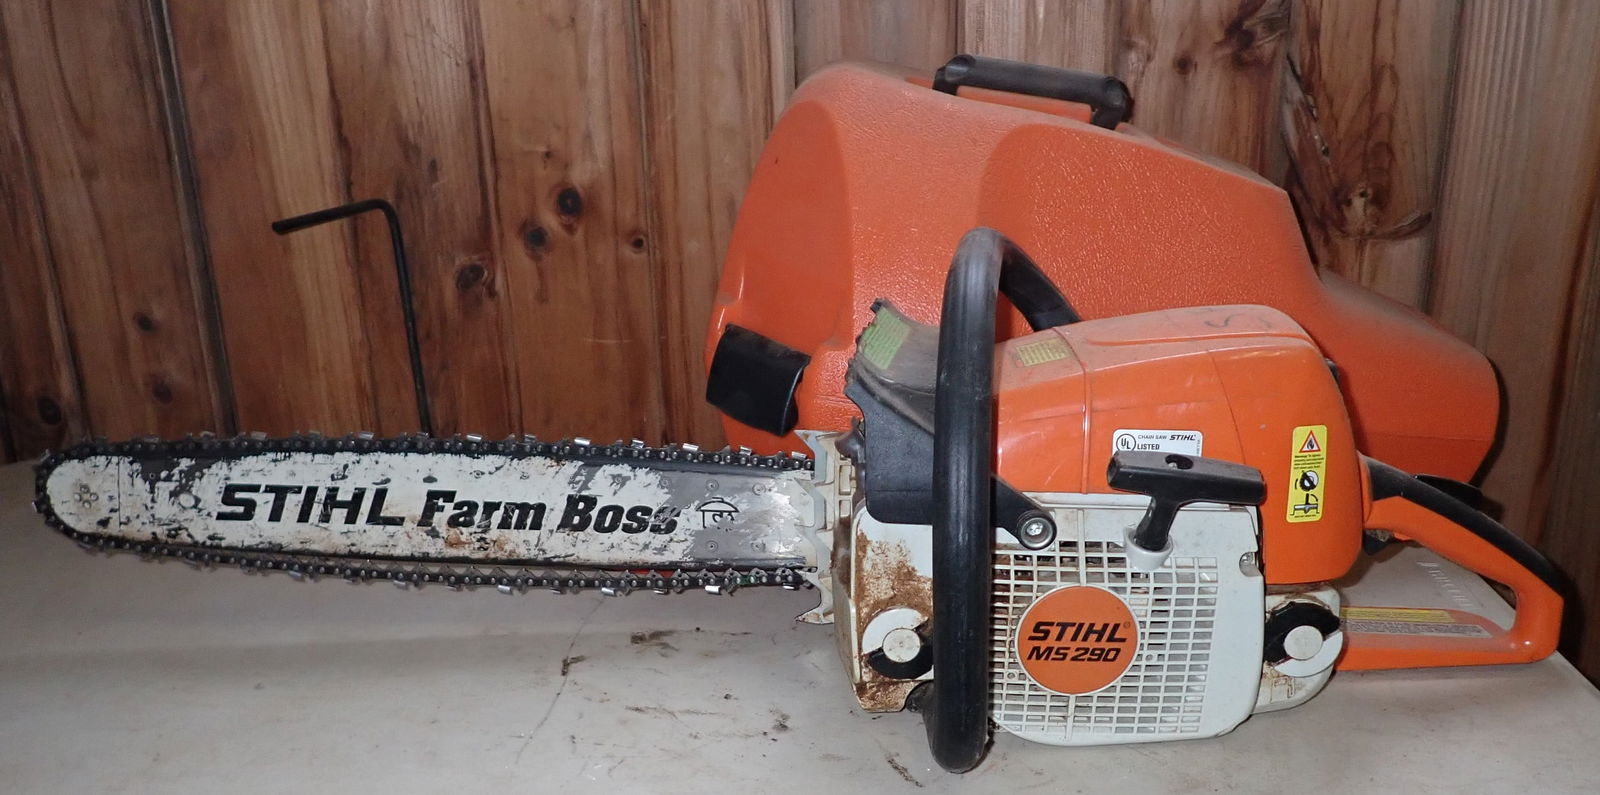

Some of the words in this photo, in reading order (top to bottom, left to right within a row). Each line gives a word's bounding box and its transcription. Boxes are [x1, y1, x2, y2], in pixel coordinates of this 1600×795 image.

[1121, 438, 1131, 449] UL
[216, 484, 405, 526] STIHL
[417, 490, 547, 531] Farm
[556, 494, 682, 535] Boss
[1028, 621, 1127, 643] STIHL
[1027, 646, 1071, 661] MS
[1071, 647, 1121, 662] 290
